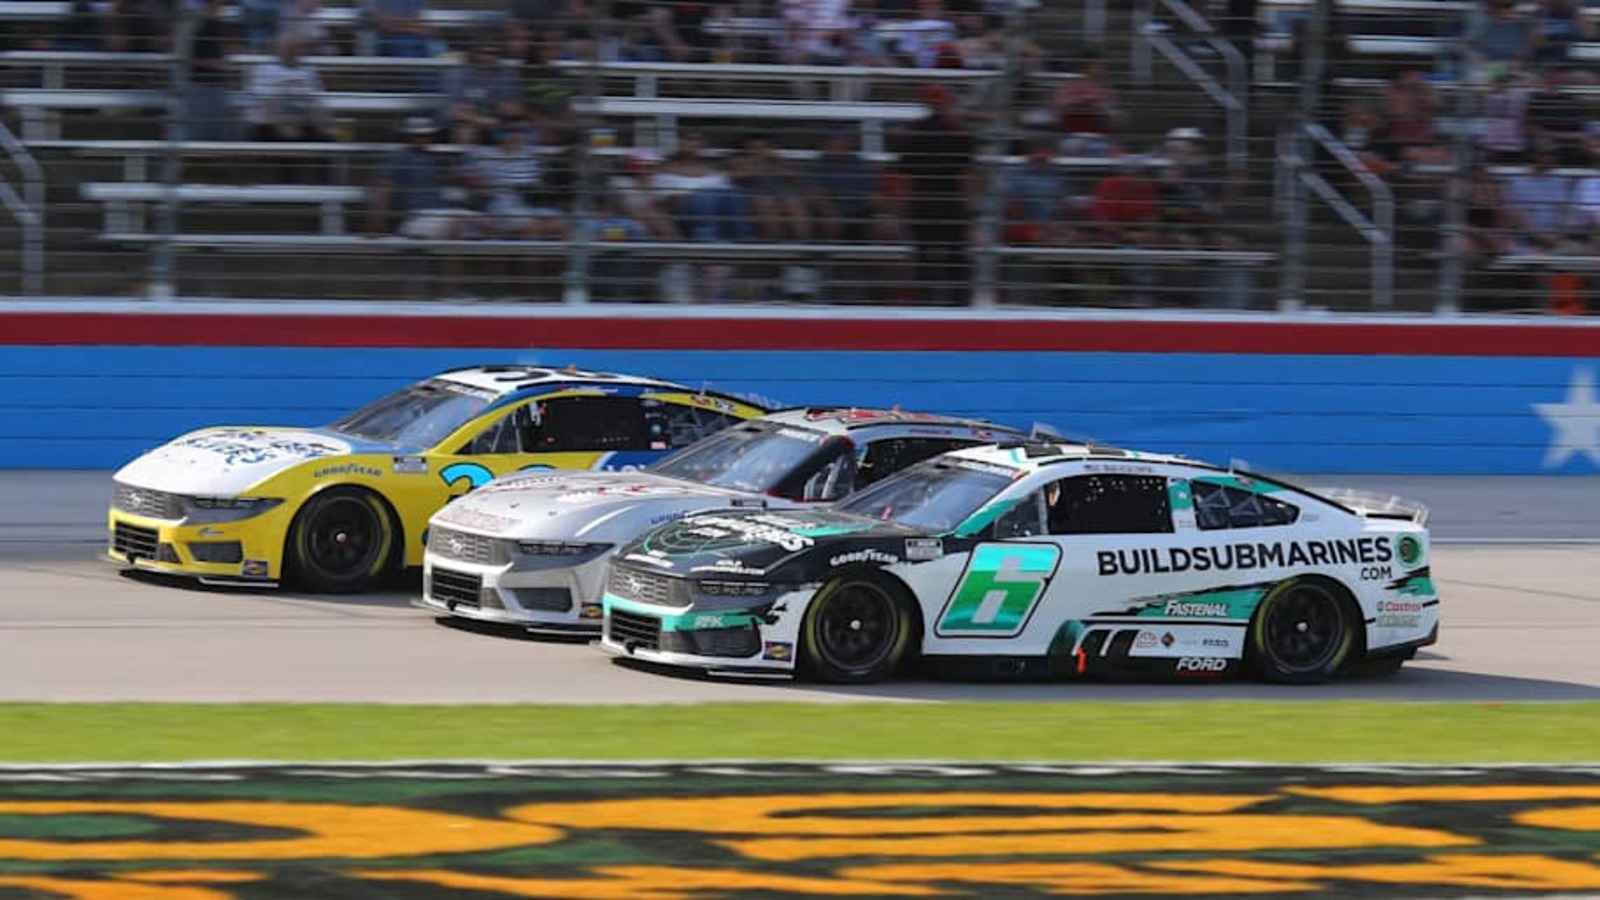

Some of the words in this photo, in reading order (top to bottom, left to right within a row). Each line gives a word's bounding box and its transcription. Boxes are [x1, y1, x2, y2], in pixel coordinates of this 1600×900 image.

[829, 549, 899, 566] GOODYEAR
[1097, 536, 1393, 576] BUILDSUBMARINES
[938, 543, 1060, 634] 6
[1176, 658, 1227, 671] FORD
